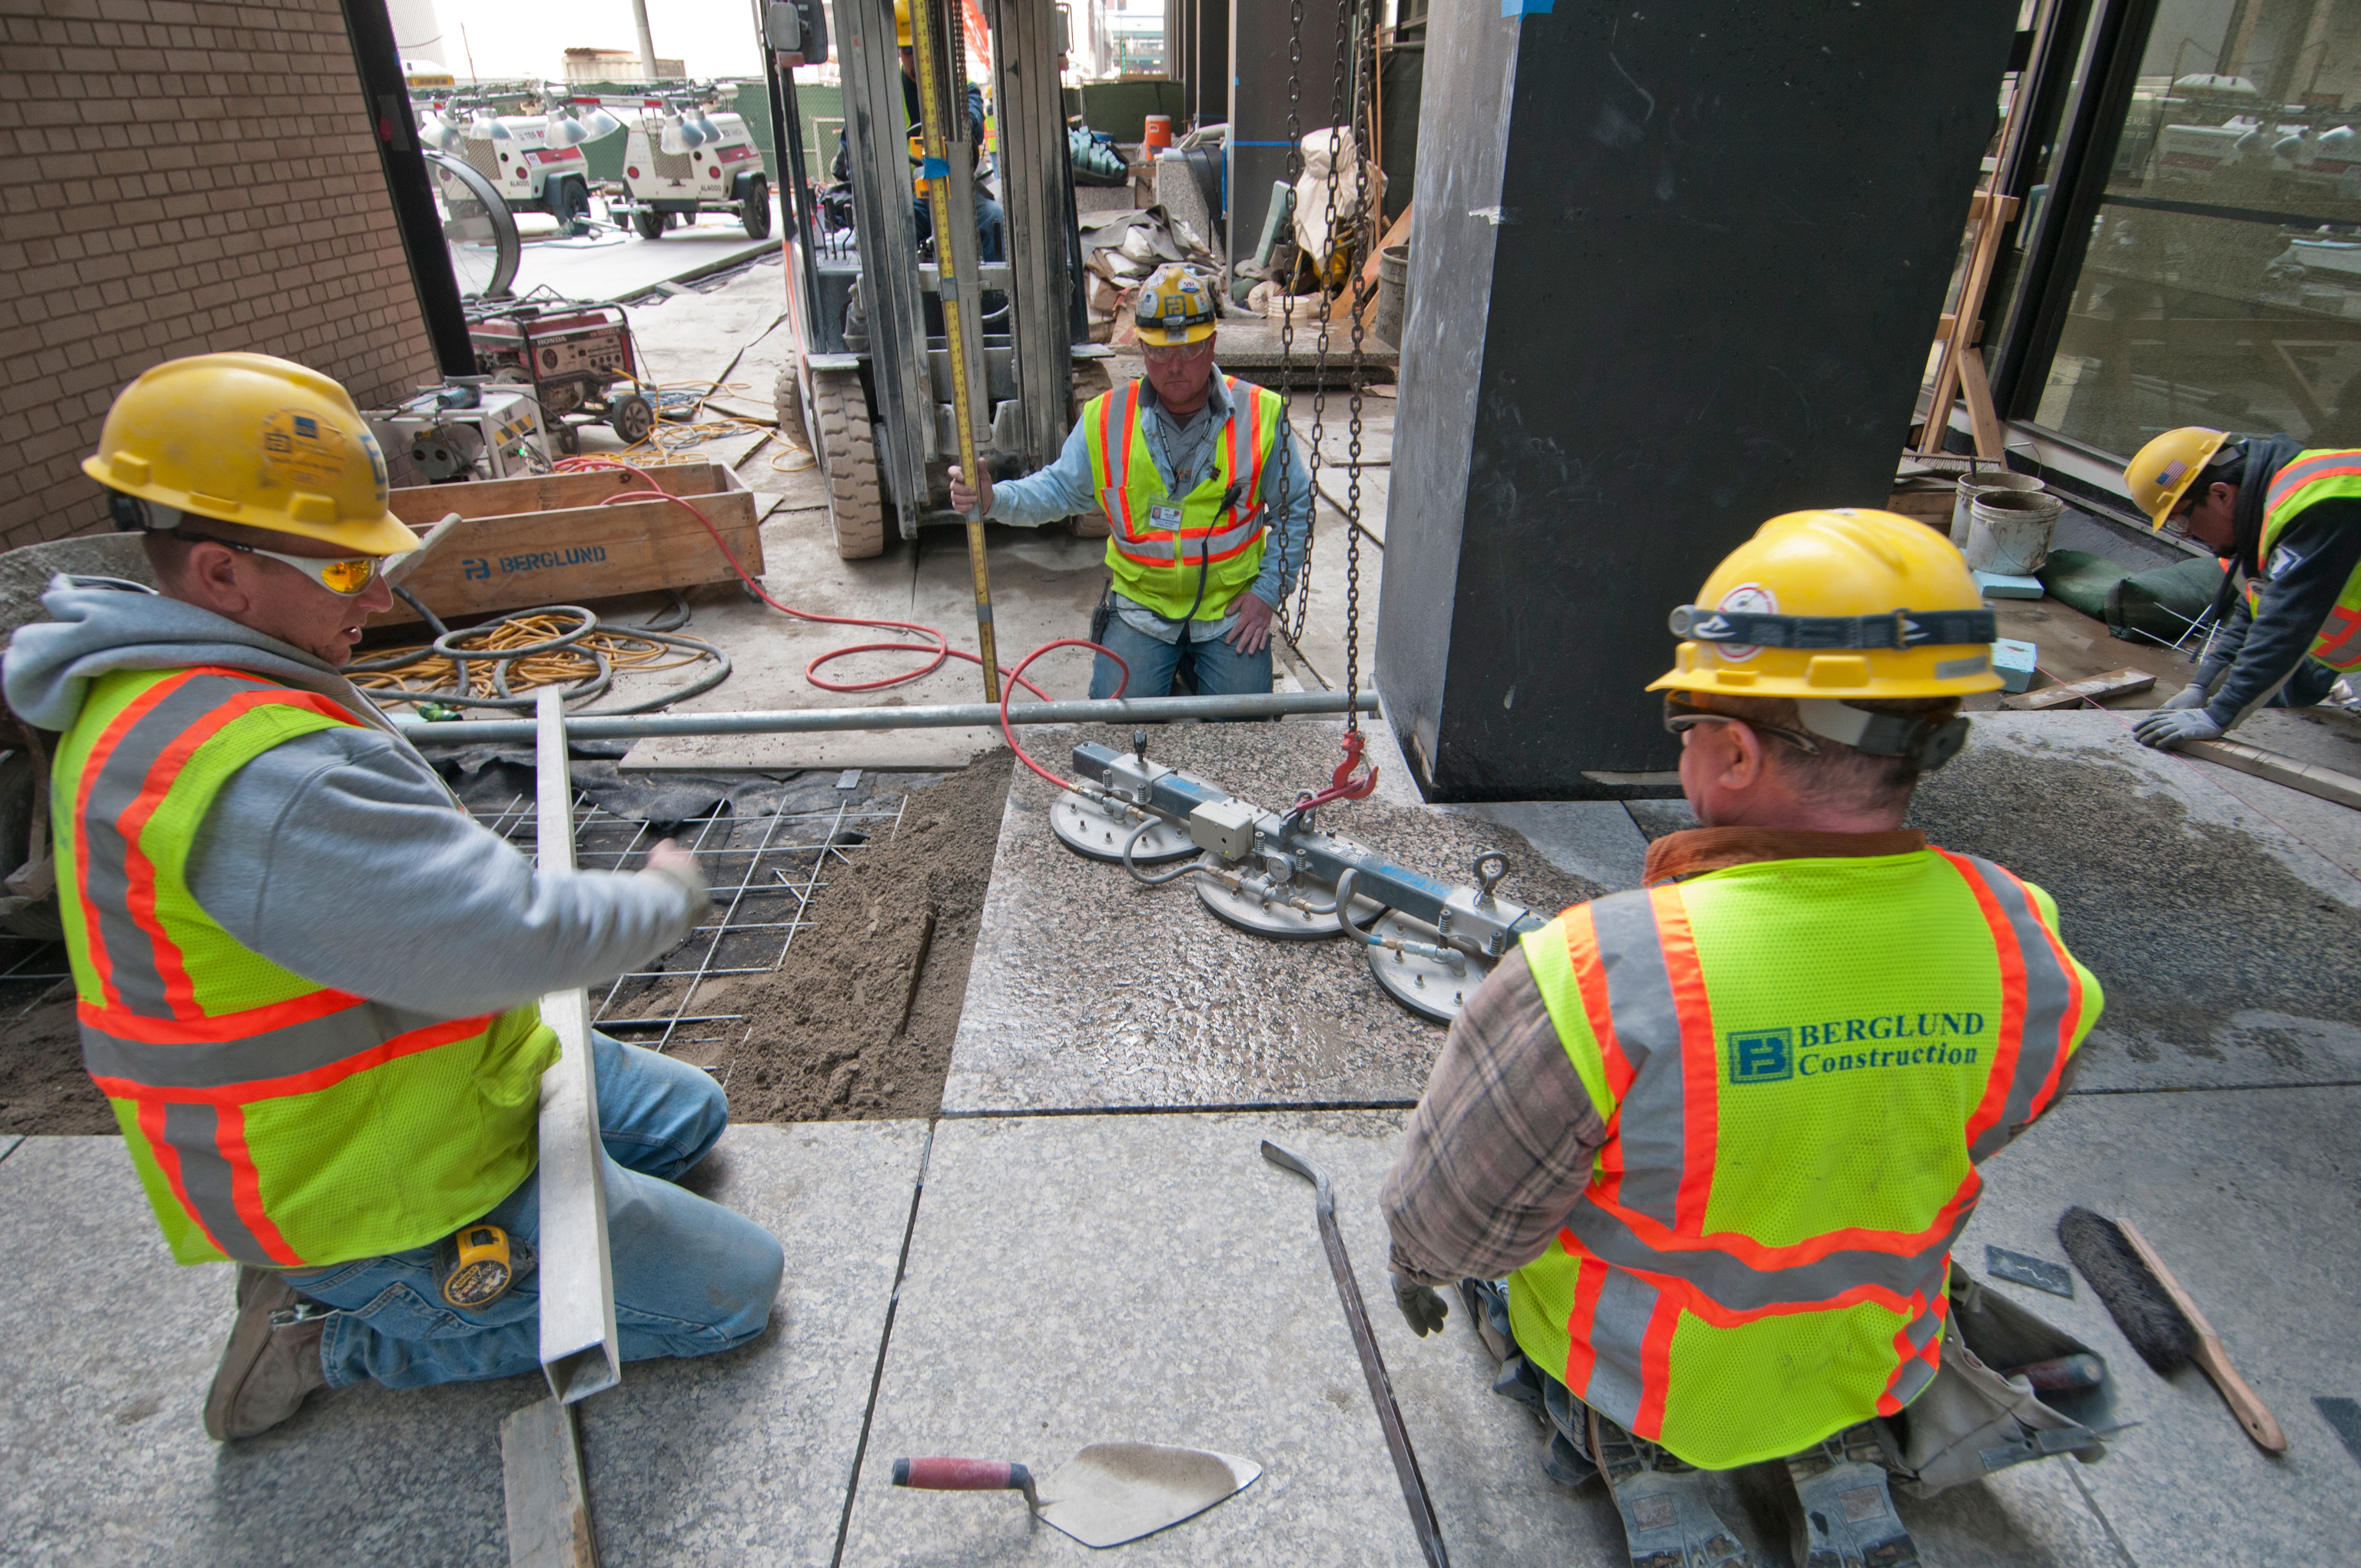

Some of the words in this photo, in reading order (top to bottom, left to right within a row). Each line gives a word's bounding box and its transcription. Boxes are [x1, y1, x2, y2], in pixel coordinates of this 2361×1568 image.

[537, 335, 567, 345] HONDA
[498, 546, 606, 574] BERGLUND
[1798, 1012, 1984, 1048] BERGLUND
[1798, 1041, 1978, 1077] Construction
[456, 1266, 477, 1287] STANLEY
